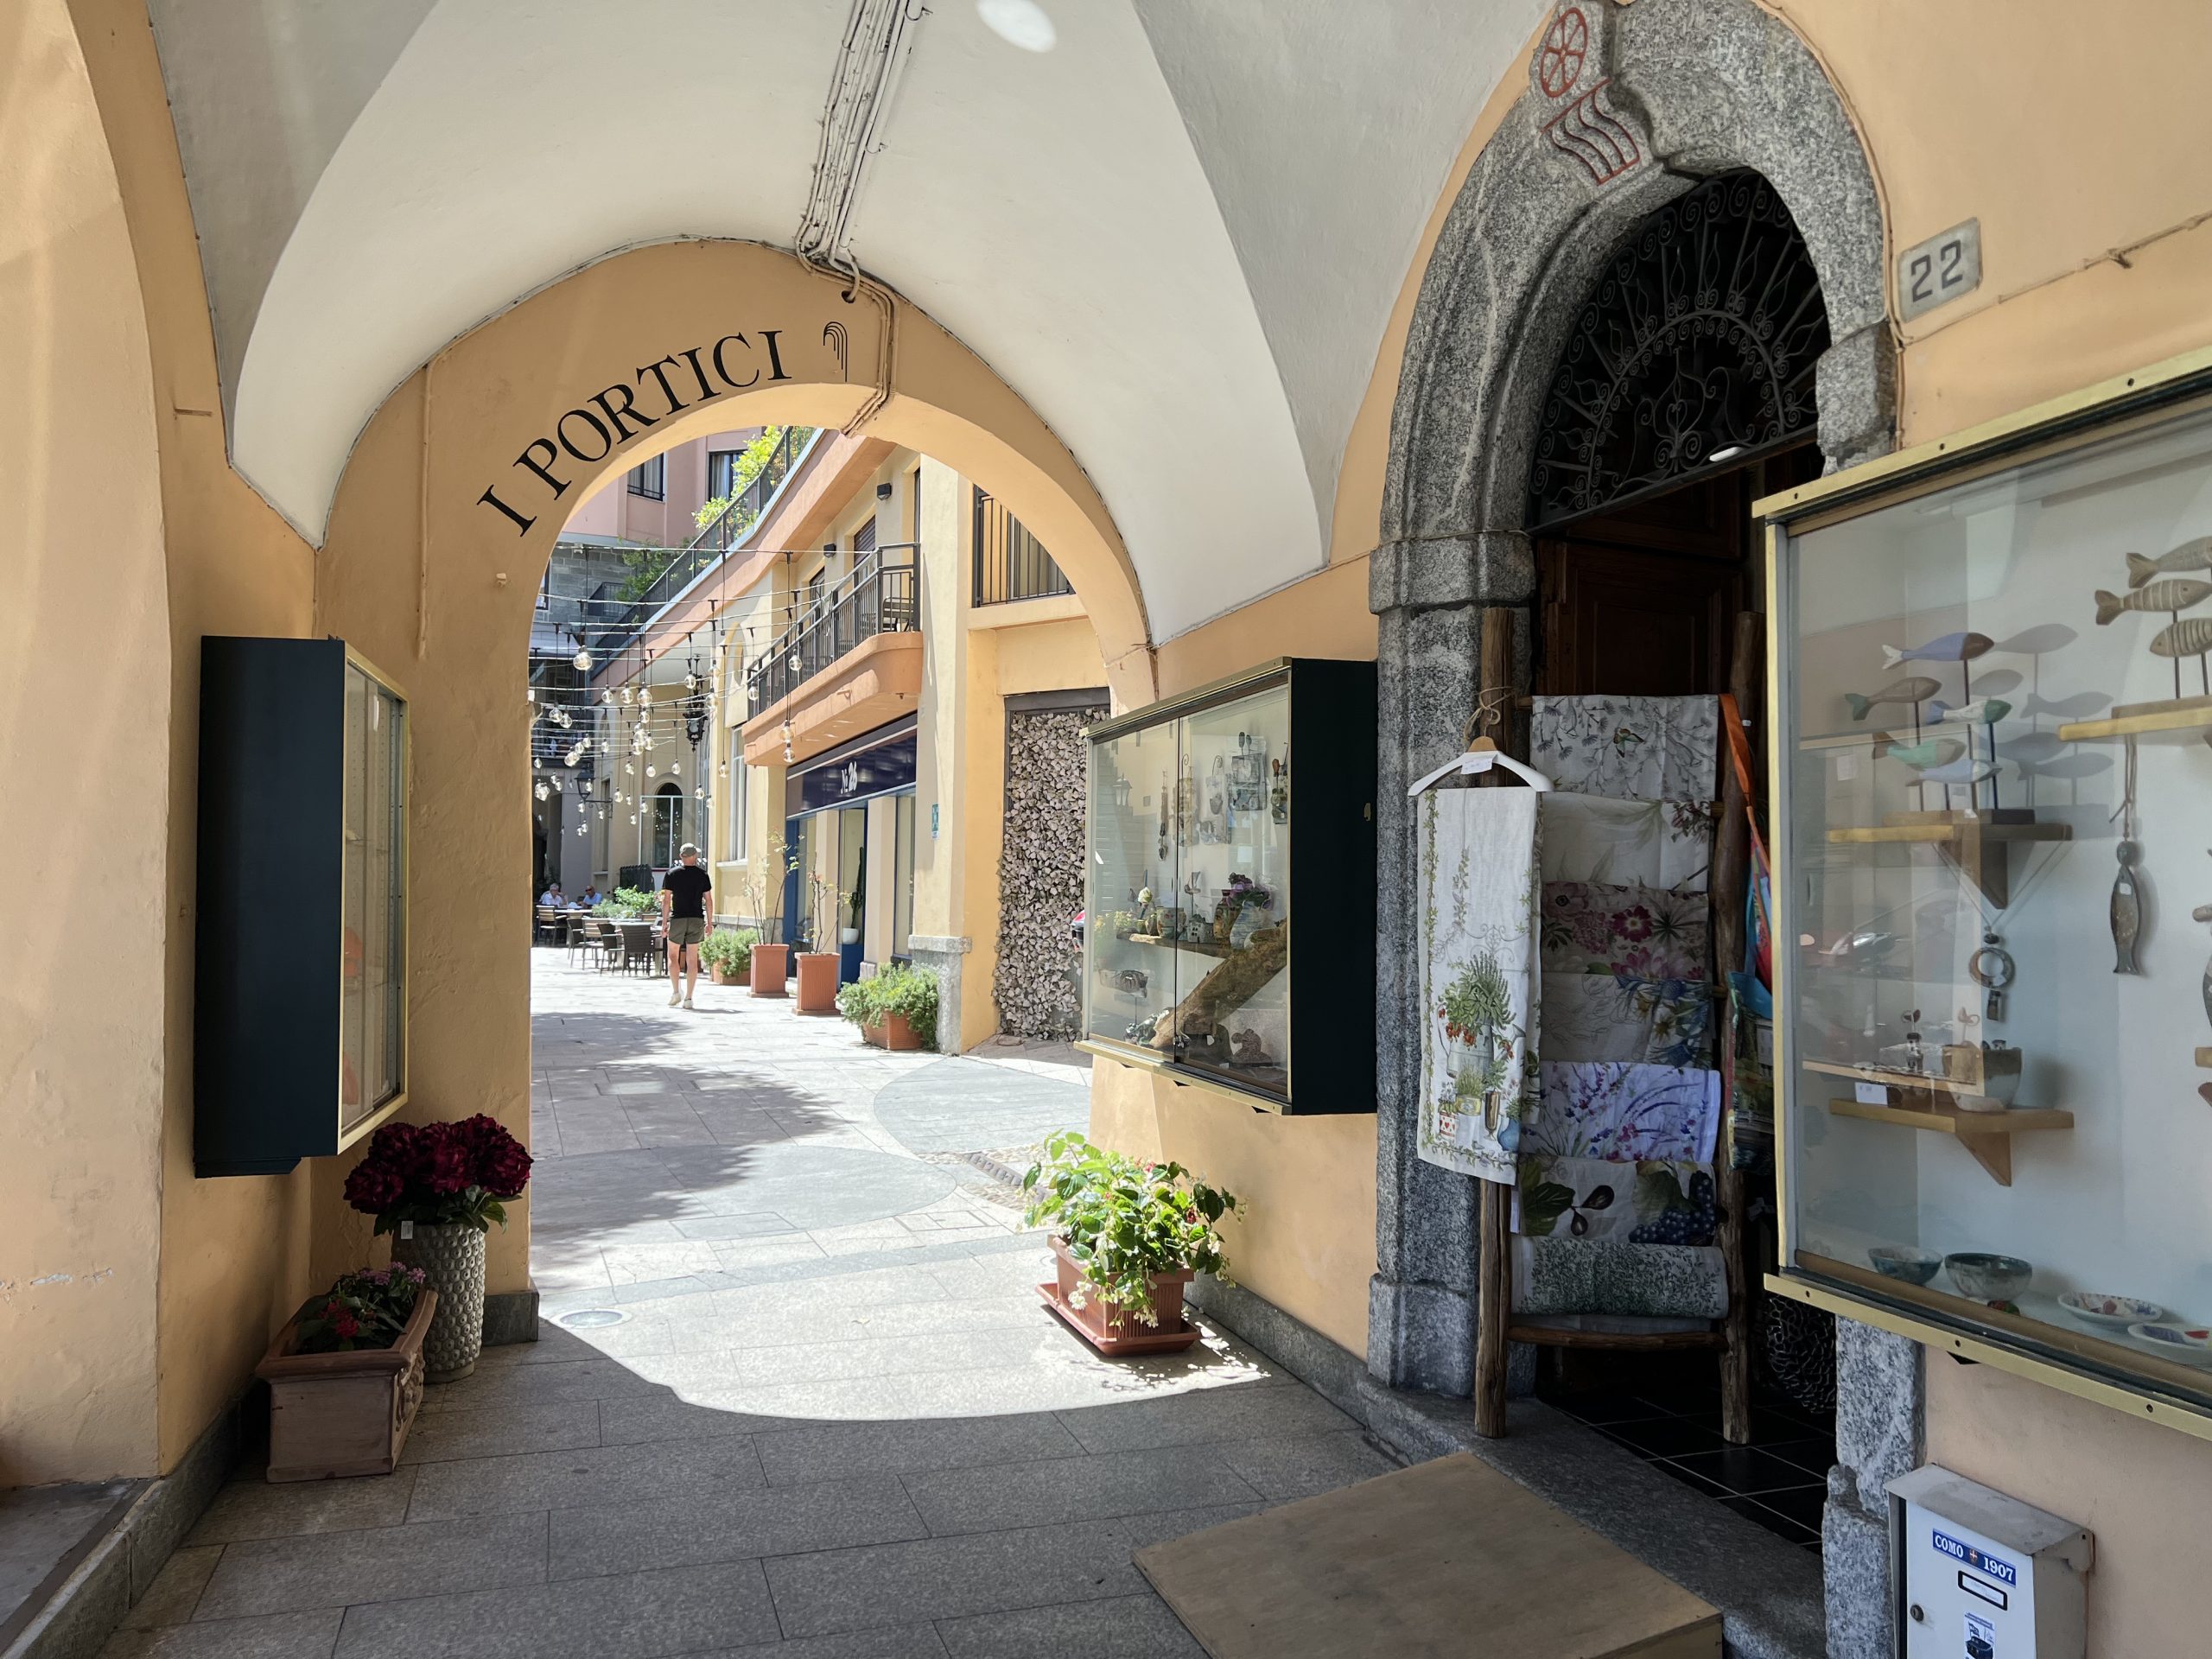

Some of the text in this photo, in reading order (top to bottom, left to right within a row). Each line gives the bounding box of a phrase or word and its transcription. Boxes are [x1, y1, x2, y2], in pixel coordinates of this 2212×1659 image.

[1910, 238, 1963, 302] 22
[476, 329, 792, 537] I PORTICI
[1935, 1535, 2014, 1581] COMO 1907
